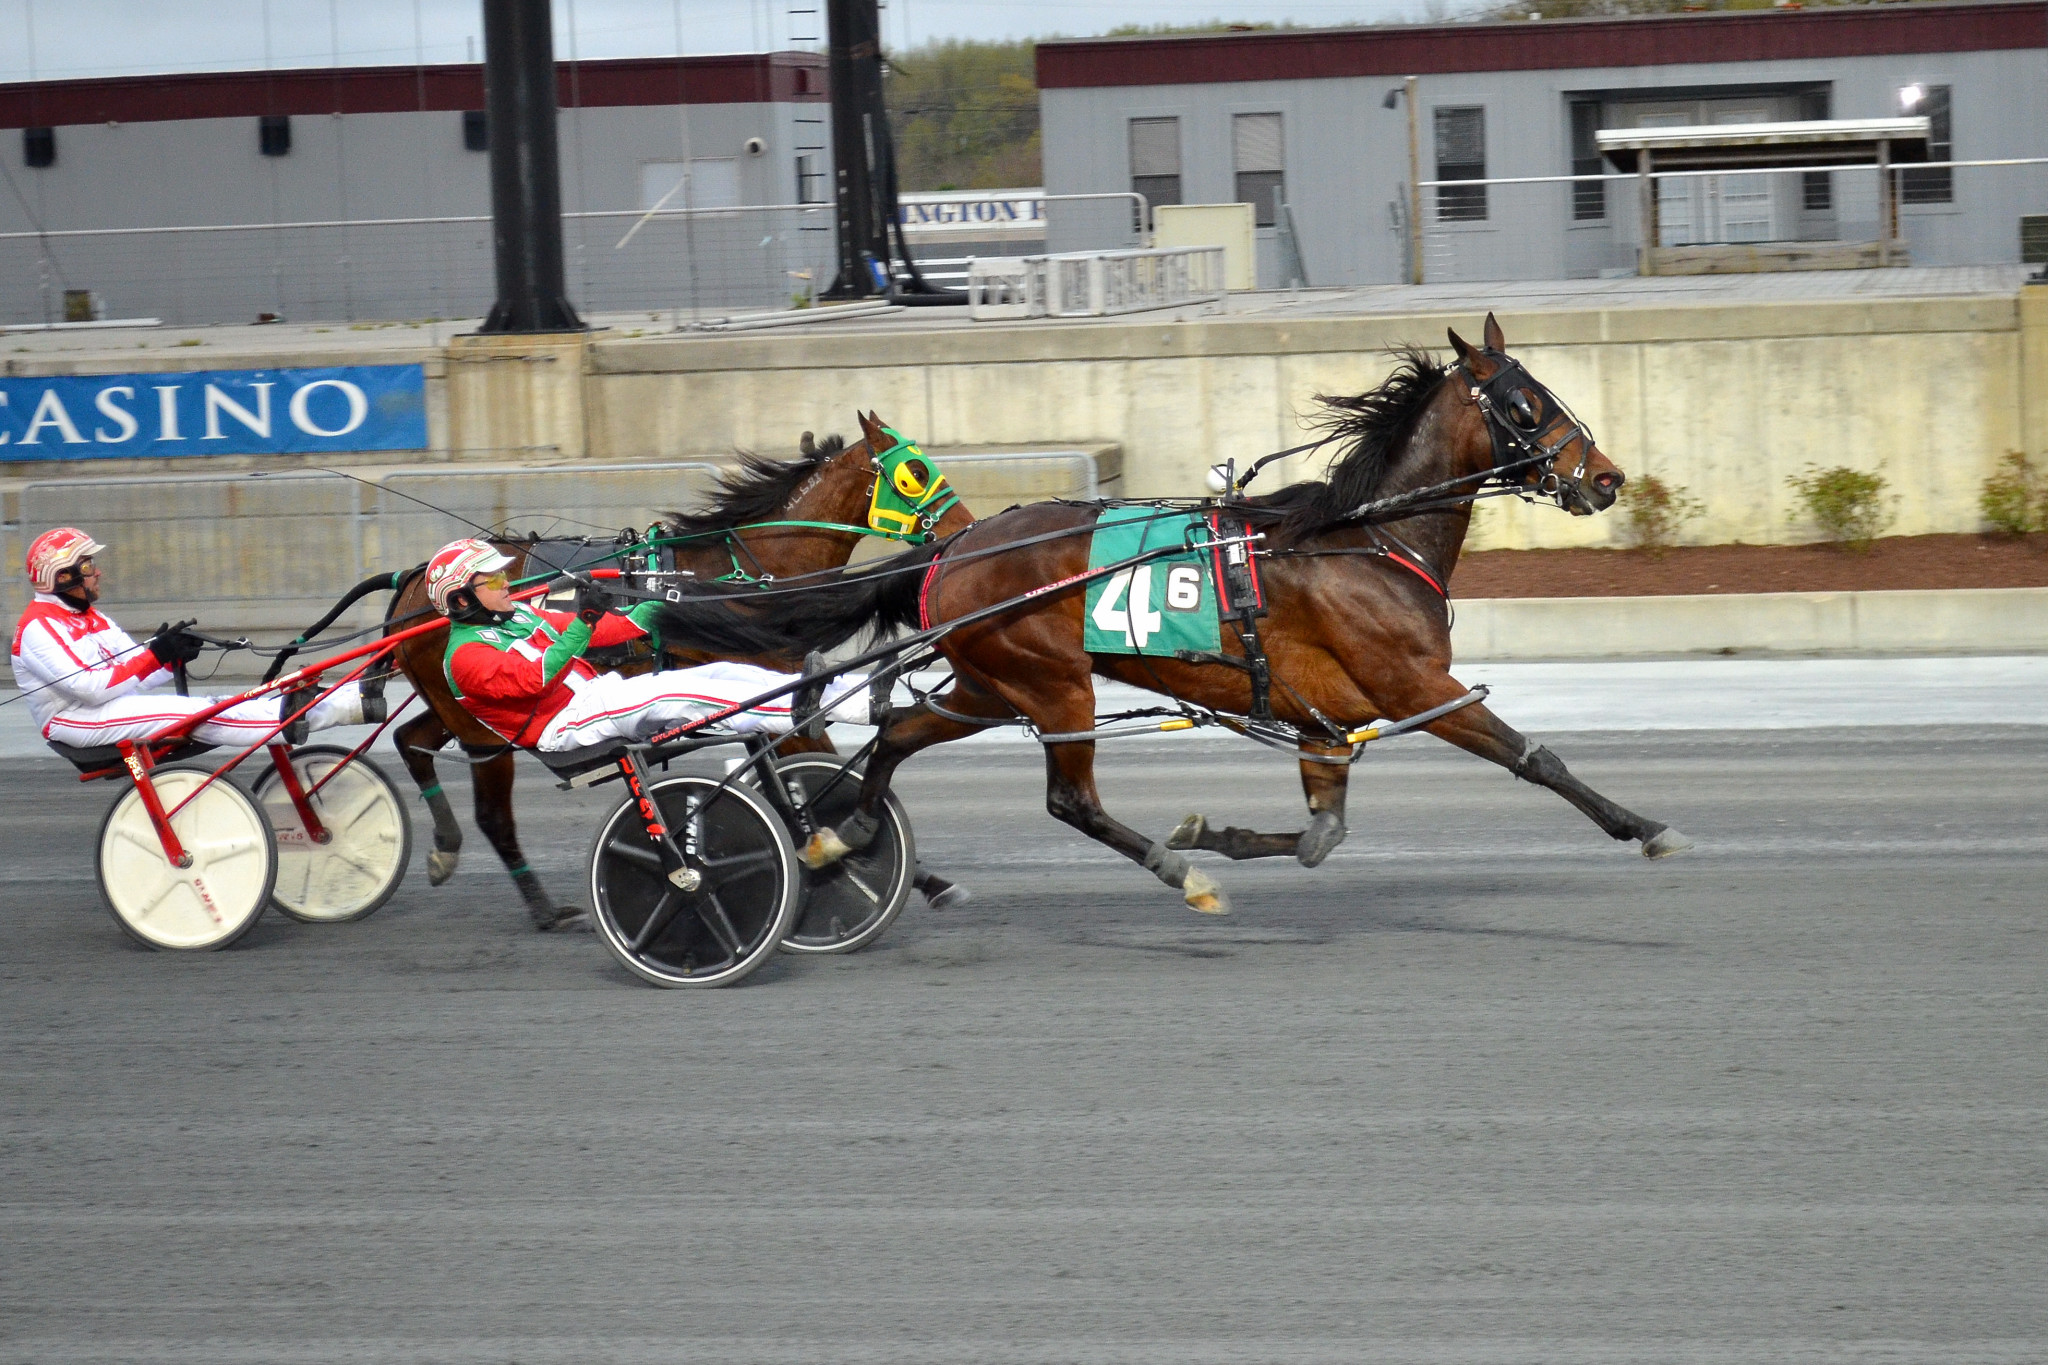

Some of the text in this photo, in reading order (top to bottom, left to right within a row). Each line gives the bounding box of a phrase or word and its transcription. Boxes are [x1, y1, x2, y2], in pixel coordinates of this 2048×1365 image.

[0, 380, 369, 445] ASINO
[1092, 565, 1161, 648] 4
[1167, 566, 1201, 610] 6
[651, 727, 680, 744] DYLAN
[707, 704, 741, 721] RACING
